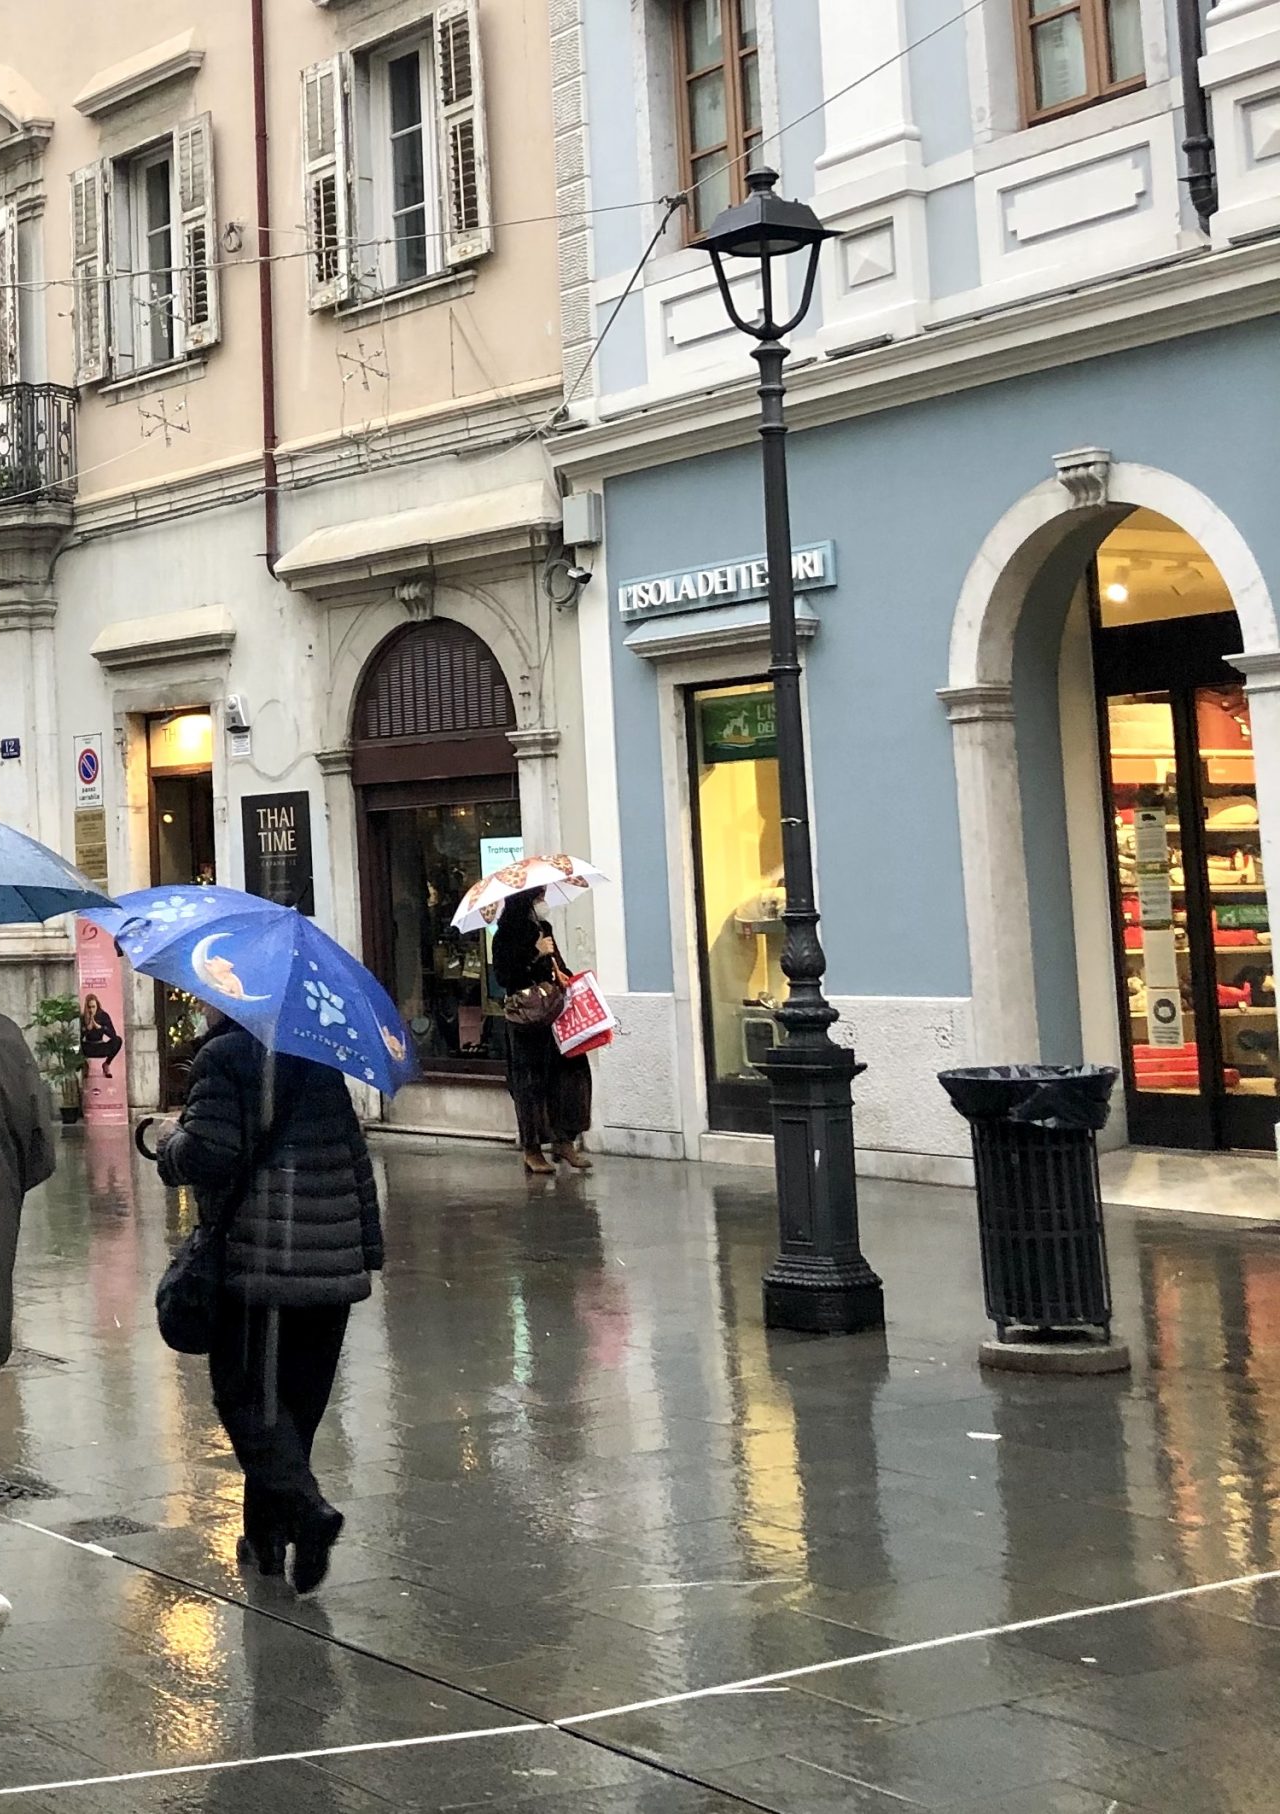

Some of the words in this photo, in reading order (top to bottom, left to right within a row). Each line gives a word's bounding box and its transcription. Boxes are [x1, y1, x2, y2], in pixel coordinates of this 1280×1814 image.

[618, 574, 697, 612] L'ISOLA
[697, 565, 737, 597] DEI
[735, 550, 824, 591] TERI
[5, 740, 15, 752] 12
[256, 806, 295, 829] THAI
[257, 830, 297, 852] TIME
